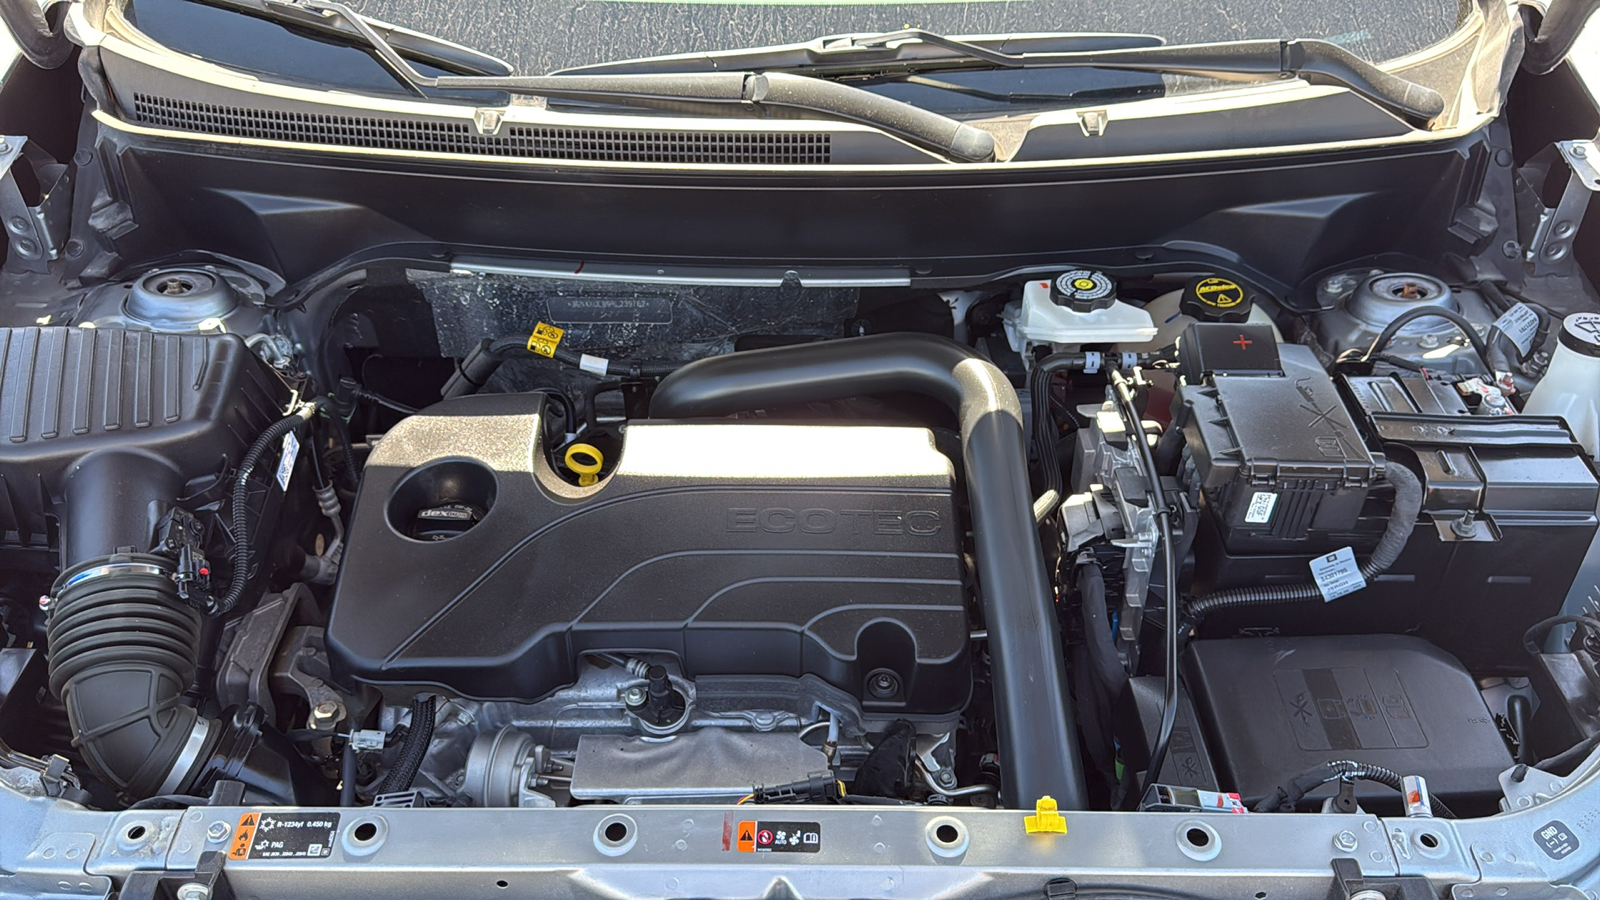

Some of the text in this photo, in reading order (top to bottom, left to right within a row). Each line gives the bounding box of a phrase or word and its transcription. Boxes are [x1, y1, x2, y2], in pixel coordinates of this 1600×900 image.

[1199, 284, 1236, 293] ACDelco
[421, 510, 468, 518] dexos
[726, 508, 941, 536] ECOTEC
[277, 820, 304, 829] R-1234yf
[1541, 826, 1558, 840] GND
